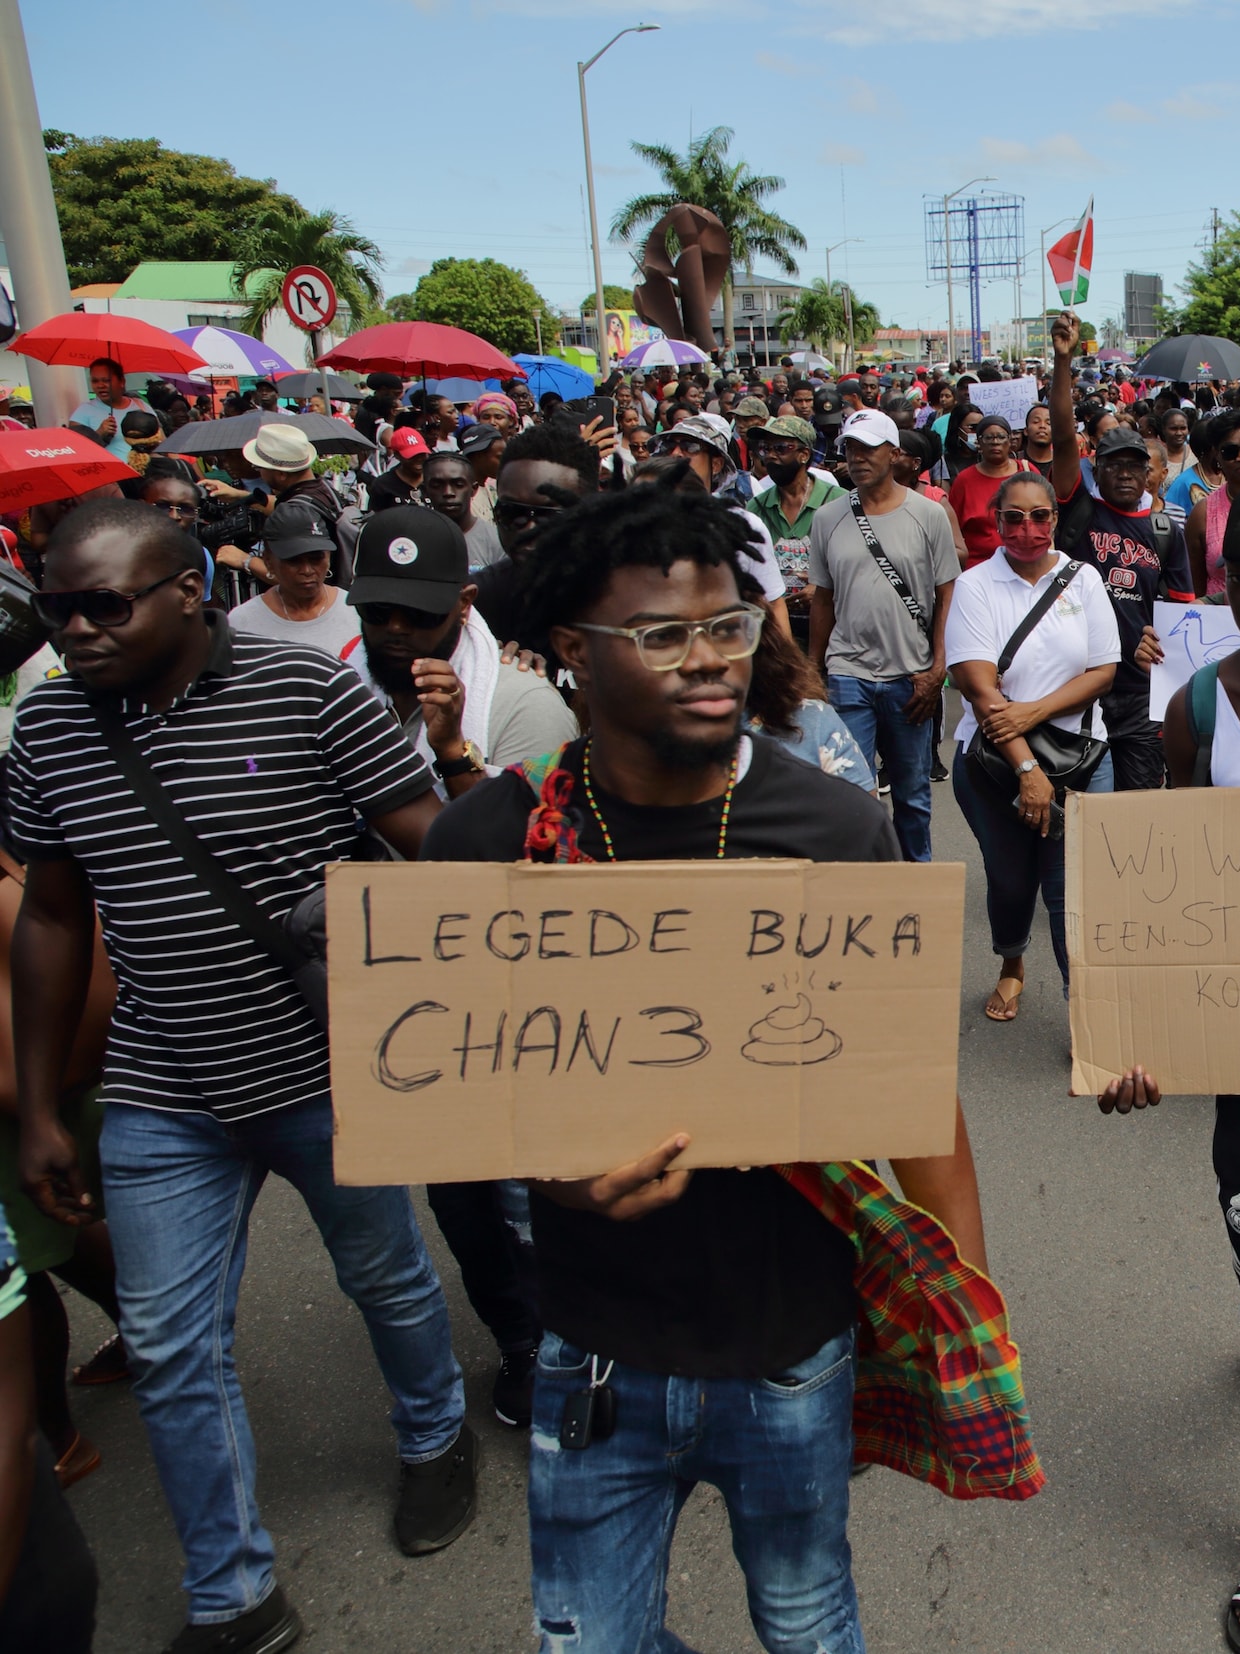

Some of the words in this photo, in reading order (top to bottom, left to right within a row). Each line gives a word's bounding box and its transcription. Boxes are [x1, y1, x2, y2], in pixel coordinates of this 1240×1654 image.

[972, 388, 998, 400] WEES
[1002, 384, 1029, 397] STIL
[26, 446, 76, 459] Digicel
[856, 515, 878, 546] NIKE
[876, 556, 903, 587] NIKE
[361, 886, 692, 966] LEGEDE
[746, 908, 923, 959] BUKA
[370, 999, 712, 1093] CHAN3
